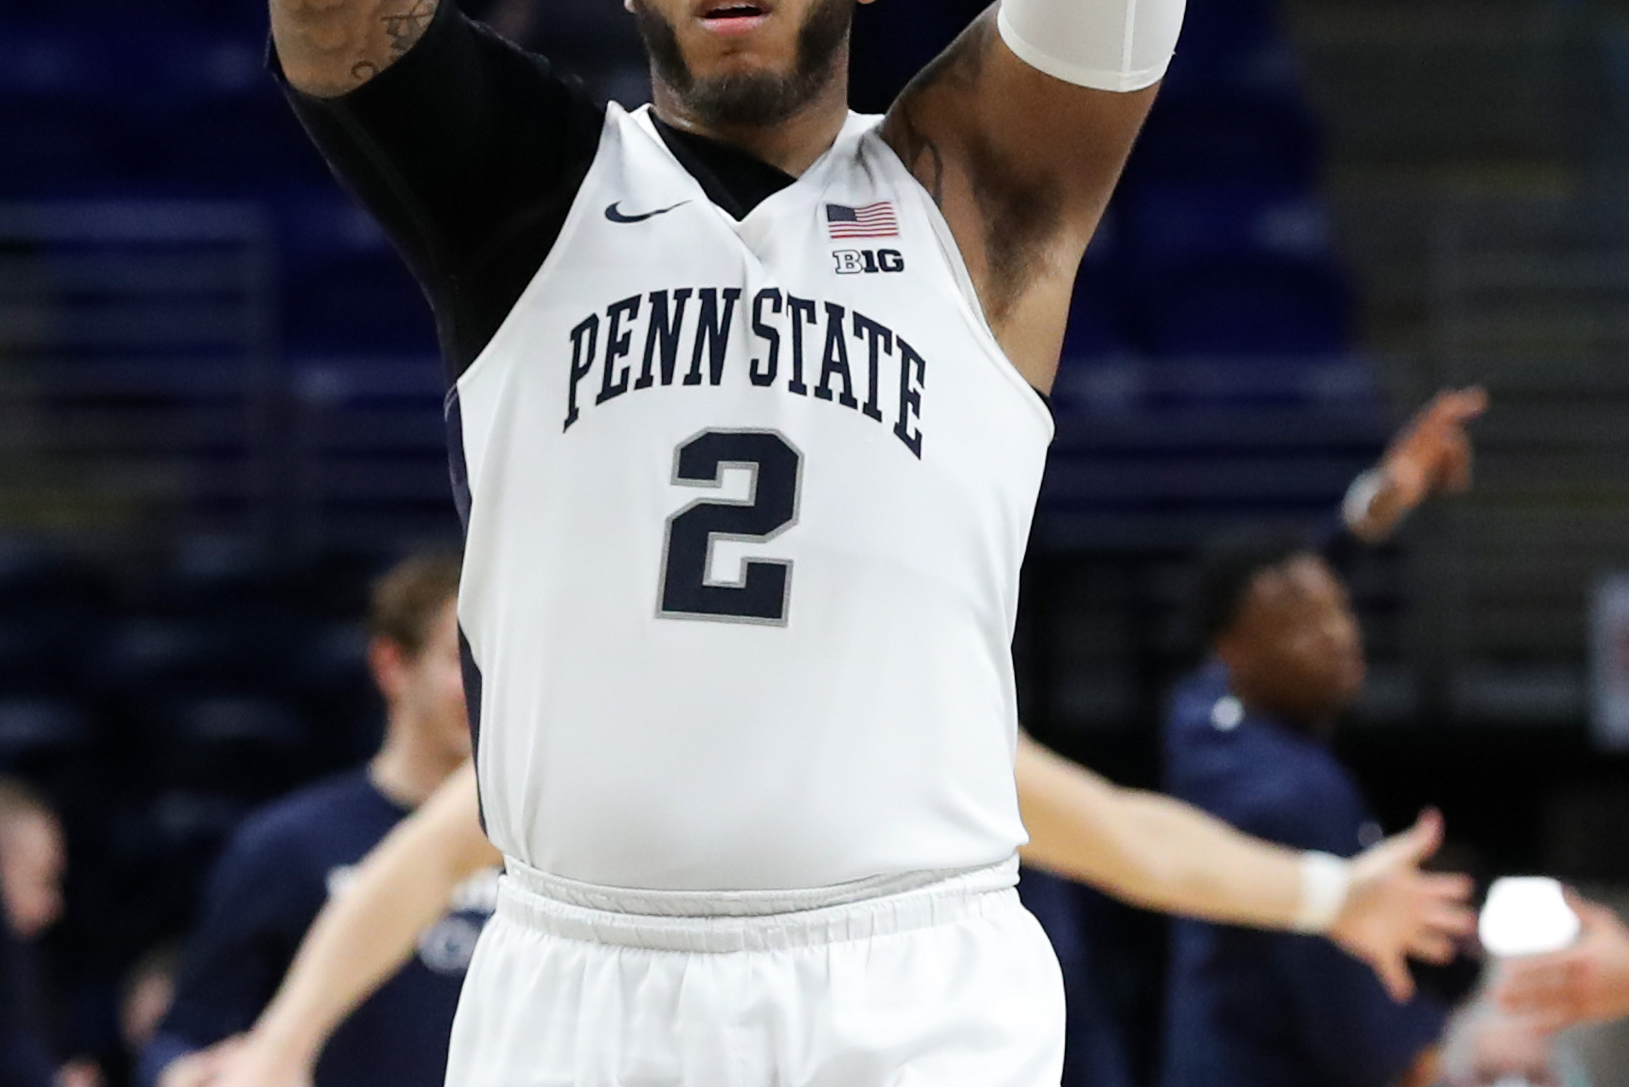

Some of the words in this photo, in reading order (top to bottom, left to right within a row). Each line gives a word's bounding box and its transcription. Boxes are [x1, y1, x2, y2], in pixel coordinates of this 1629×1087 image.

[562, 287, 741, 434] PENN
[748, 287, 926, 461] STATE
[654, 426, 805, 628] 2
